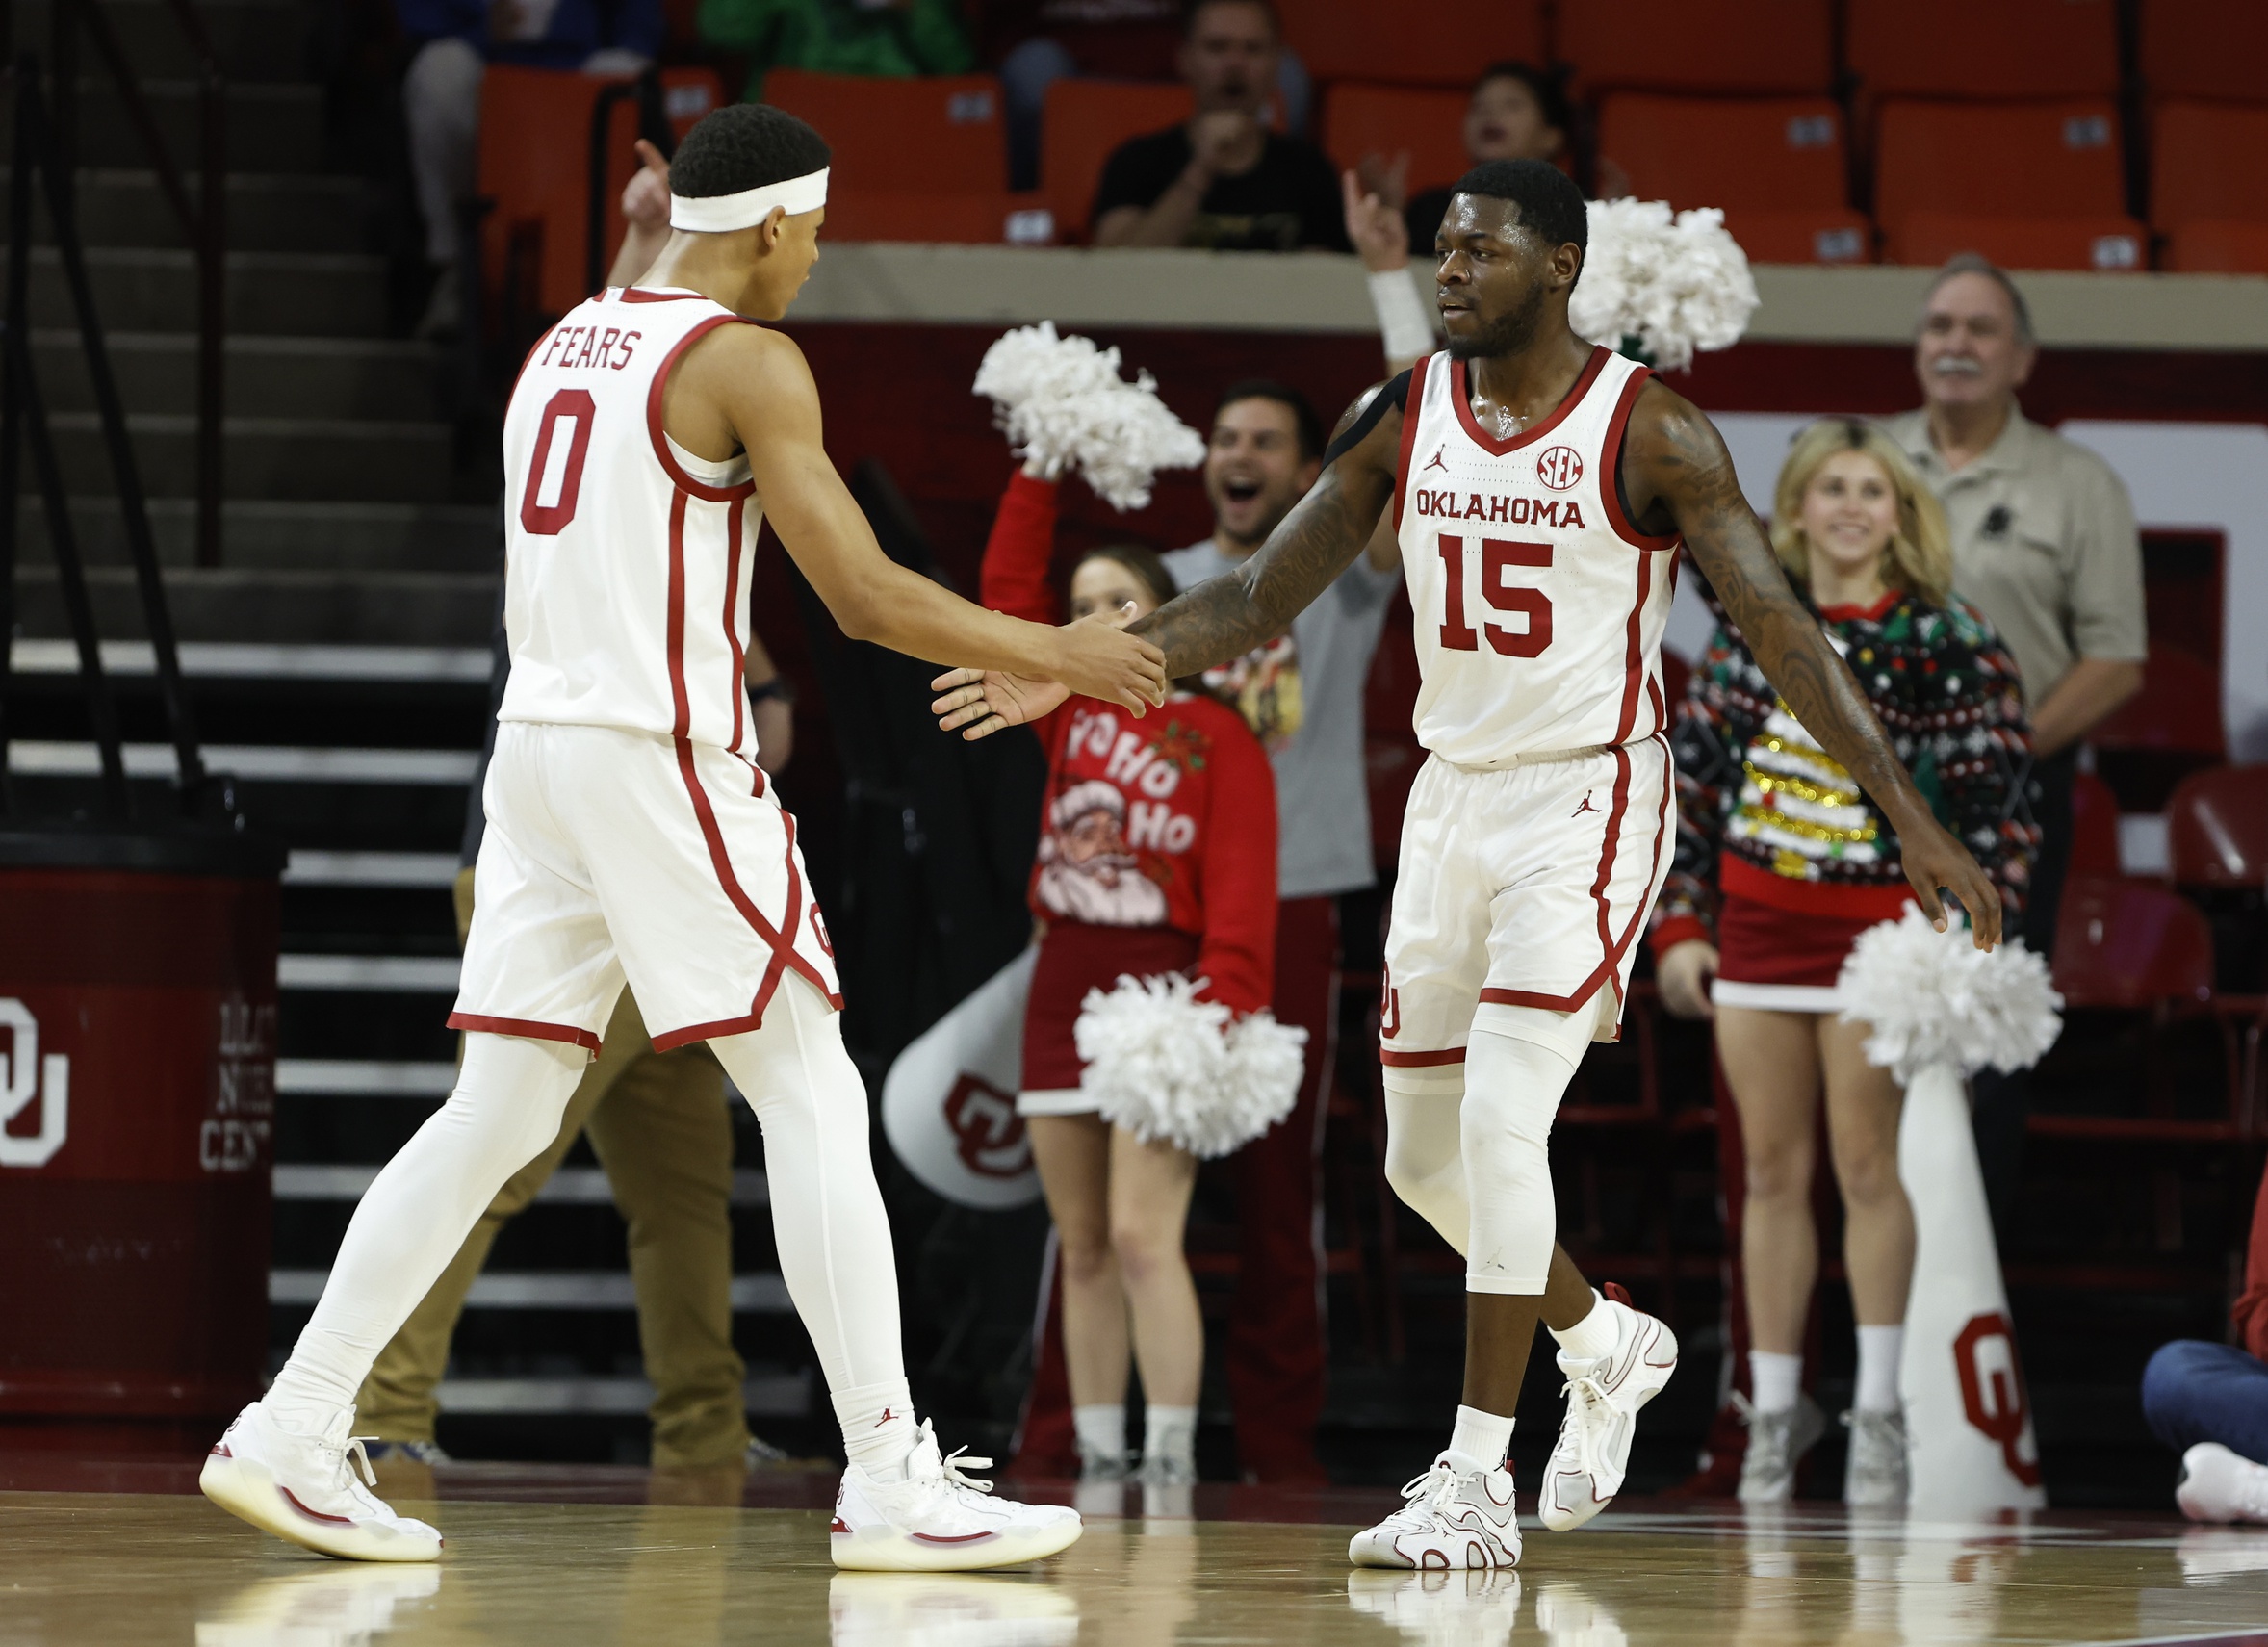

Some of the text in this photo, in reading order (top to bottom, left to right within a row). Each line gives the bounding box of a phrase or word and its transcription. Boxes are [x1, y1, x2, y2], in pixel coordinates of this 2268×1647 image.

[541, 325, 642, 371] FEARS
[520, 388, 596, 536] 0
[1538, 447, 1583, 489] SEC
[1416, 489, 1586, 529] OKLAHOMA
[1437, 532, 1555, 658] 15
